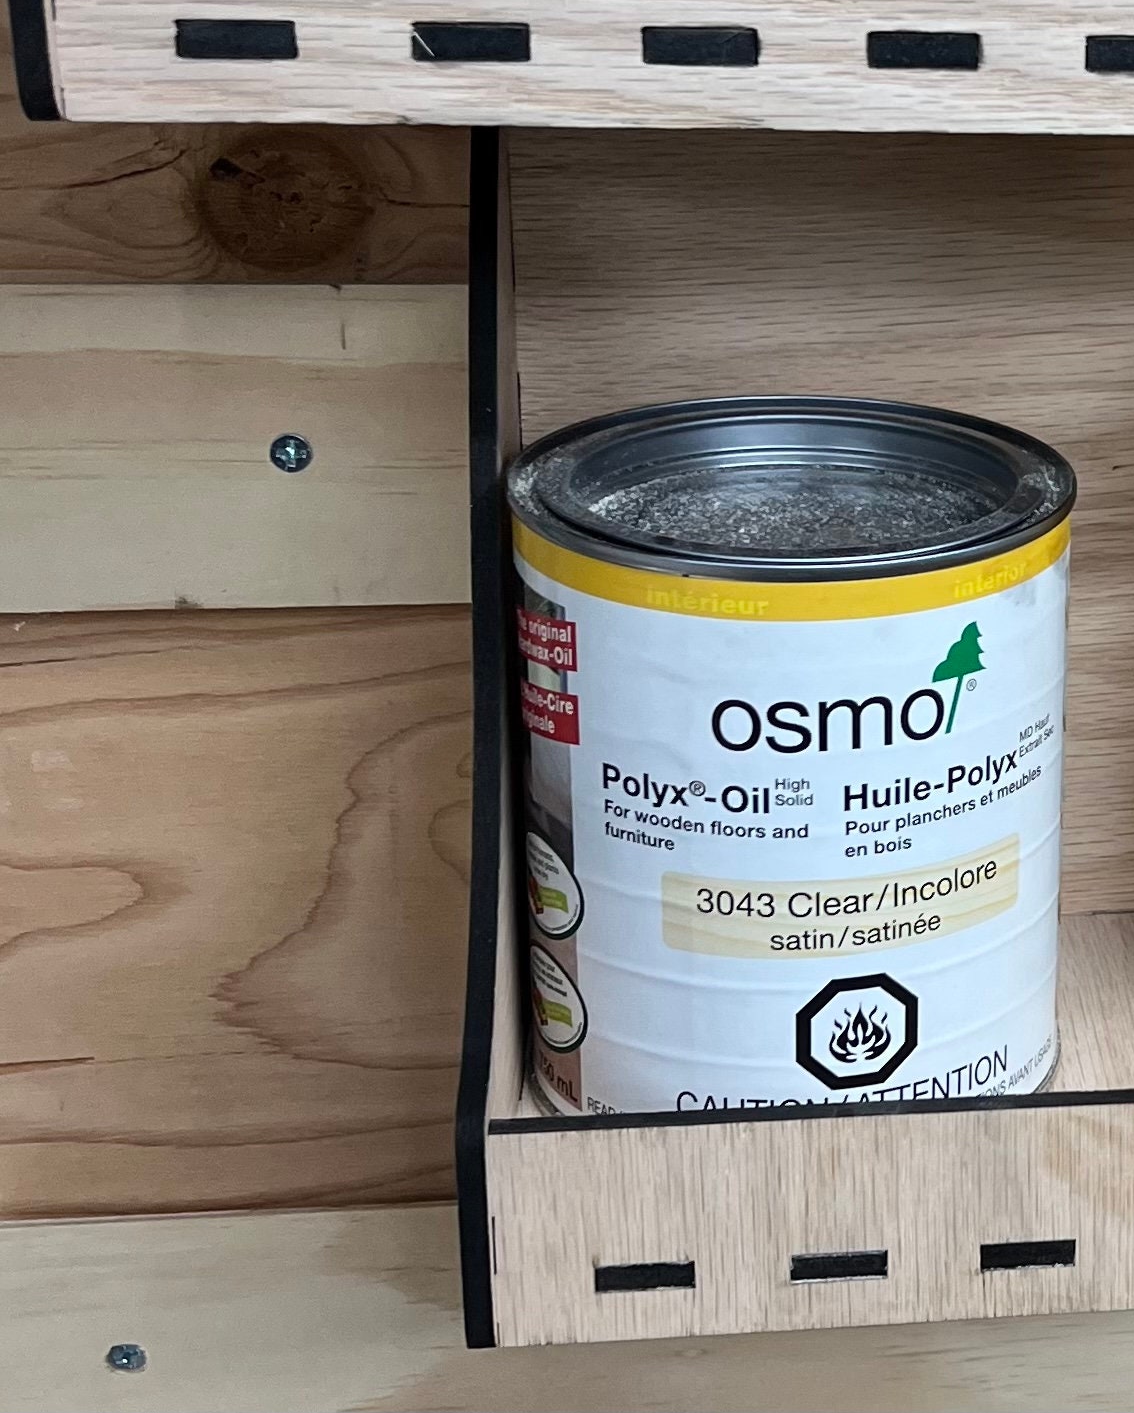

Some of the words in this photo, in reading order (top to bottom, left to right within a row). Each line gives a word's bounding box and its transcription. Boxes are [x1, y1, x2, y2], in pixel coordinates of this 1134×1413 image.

[711, 688, 945, 754] osmo
[774, 778, 810, 793] High
[843, 749, 1018, 812] Huile-Polyx
[774, 794, 814, 806] Solid
[845, 818, 890, 836] Pour
[895, 799, 976, 832] planchers
[980, 790, 994, 807] et
[997, 765, 1042, 800] meubles
[604, 799, 631, 819] For
[634, 810, 705, 834] wooden
[710, 820, 766, 840] floors
[772, 823, 809, 839] and
[604, 821, 676, 851] furniture
[845, 843, 868, 858] en
[874, 836, 912, 855] bois
[696, 888, 775, 918] 3043
[556, 1075, 578, 1102] mL
